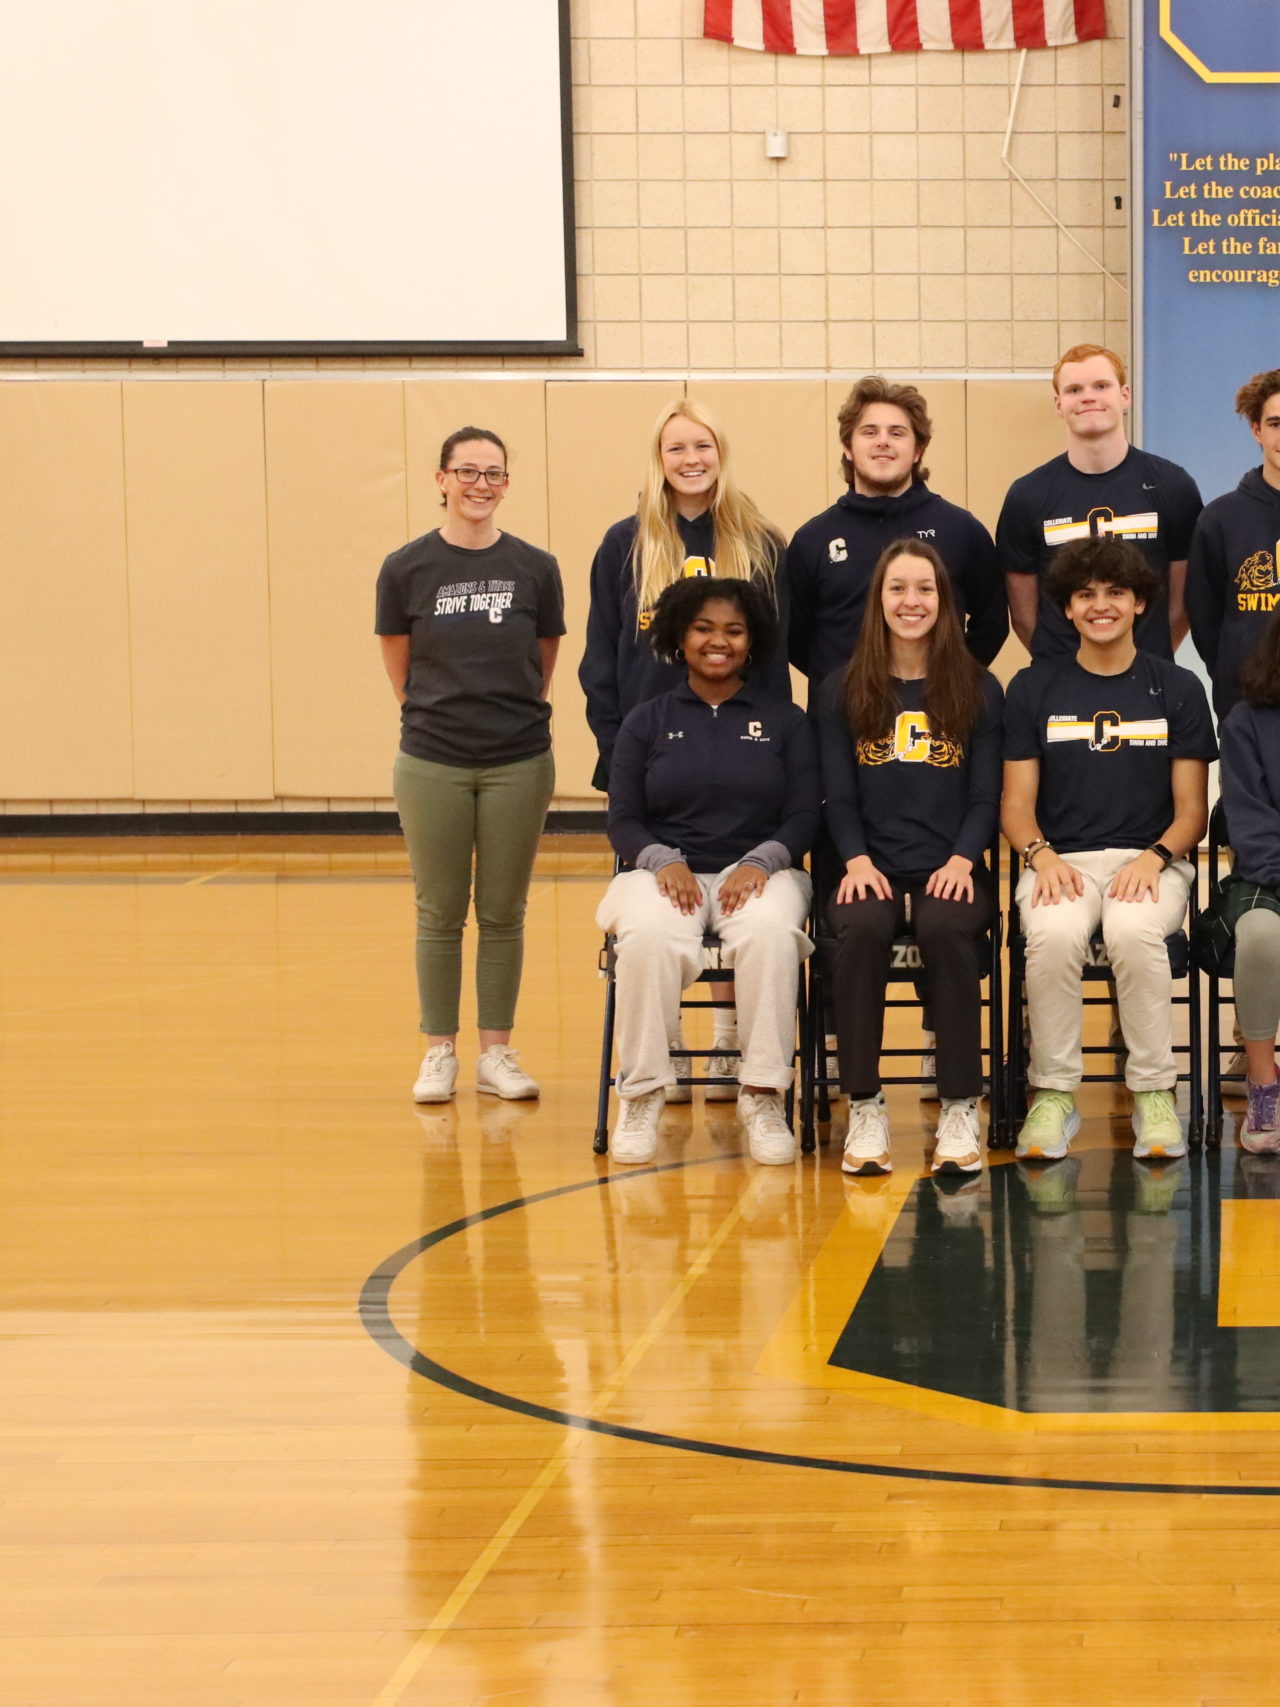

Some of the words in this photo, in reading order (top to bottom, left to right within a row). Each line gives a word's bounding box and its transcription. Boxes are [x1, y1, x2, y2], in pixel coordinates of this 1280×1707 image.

[1169, 153, 1213, 171] "Let
[1219, 153, 1250, 171] the
[1163, 181, 1197, 199] Let
[1203, 181, 1234, 199] the
[1151, 209, 1184, 227] Let
[1191, 209, 1222, 227] the
[1182, 237, 1216, 255] Let
[1222, 237, 1253, 255] the
[917, 529, 936, 538] TYR
[436, 582, 477, 598] AMAZONS
[434, 596, 468, 615] STRIVE
[469, 592, 513, 611] TOGETHER
[489, 607, 503, 624] C
[748, 721, 762, 737] C
[895, 710, 930, 763] C
